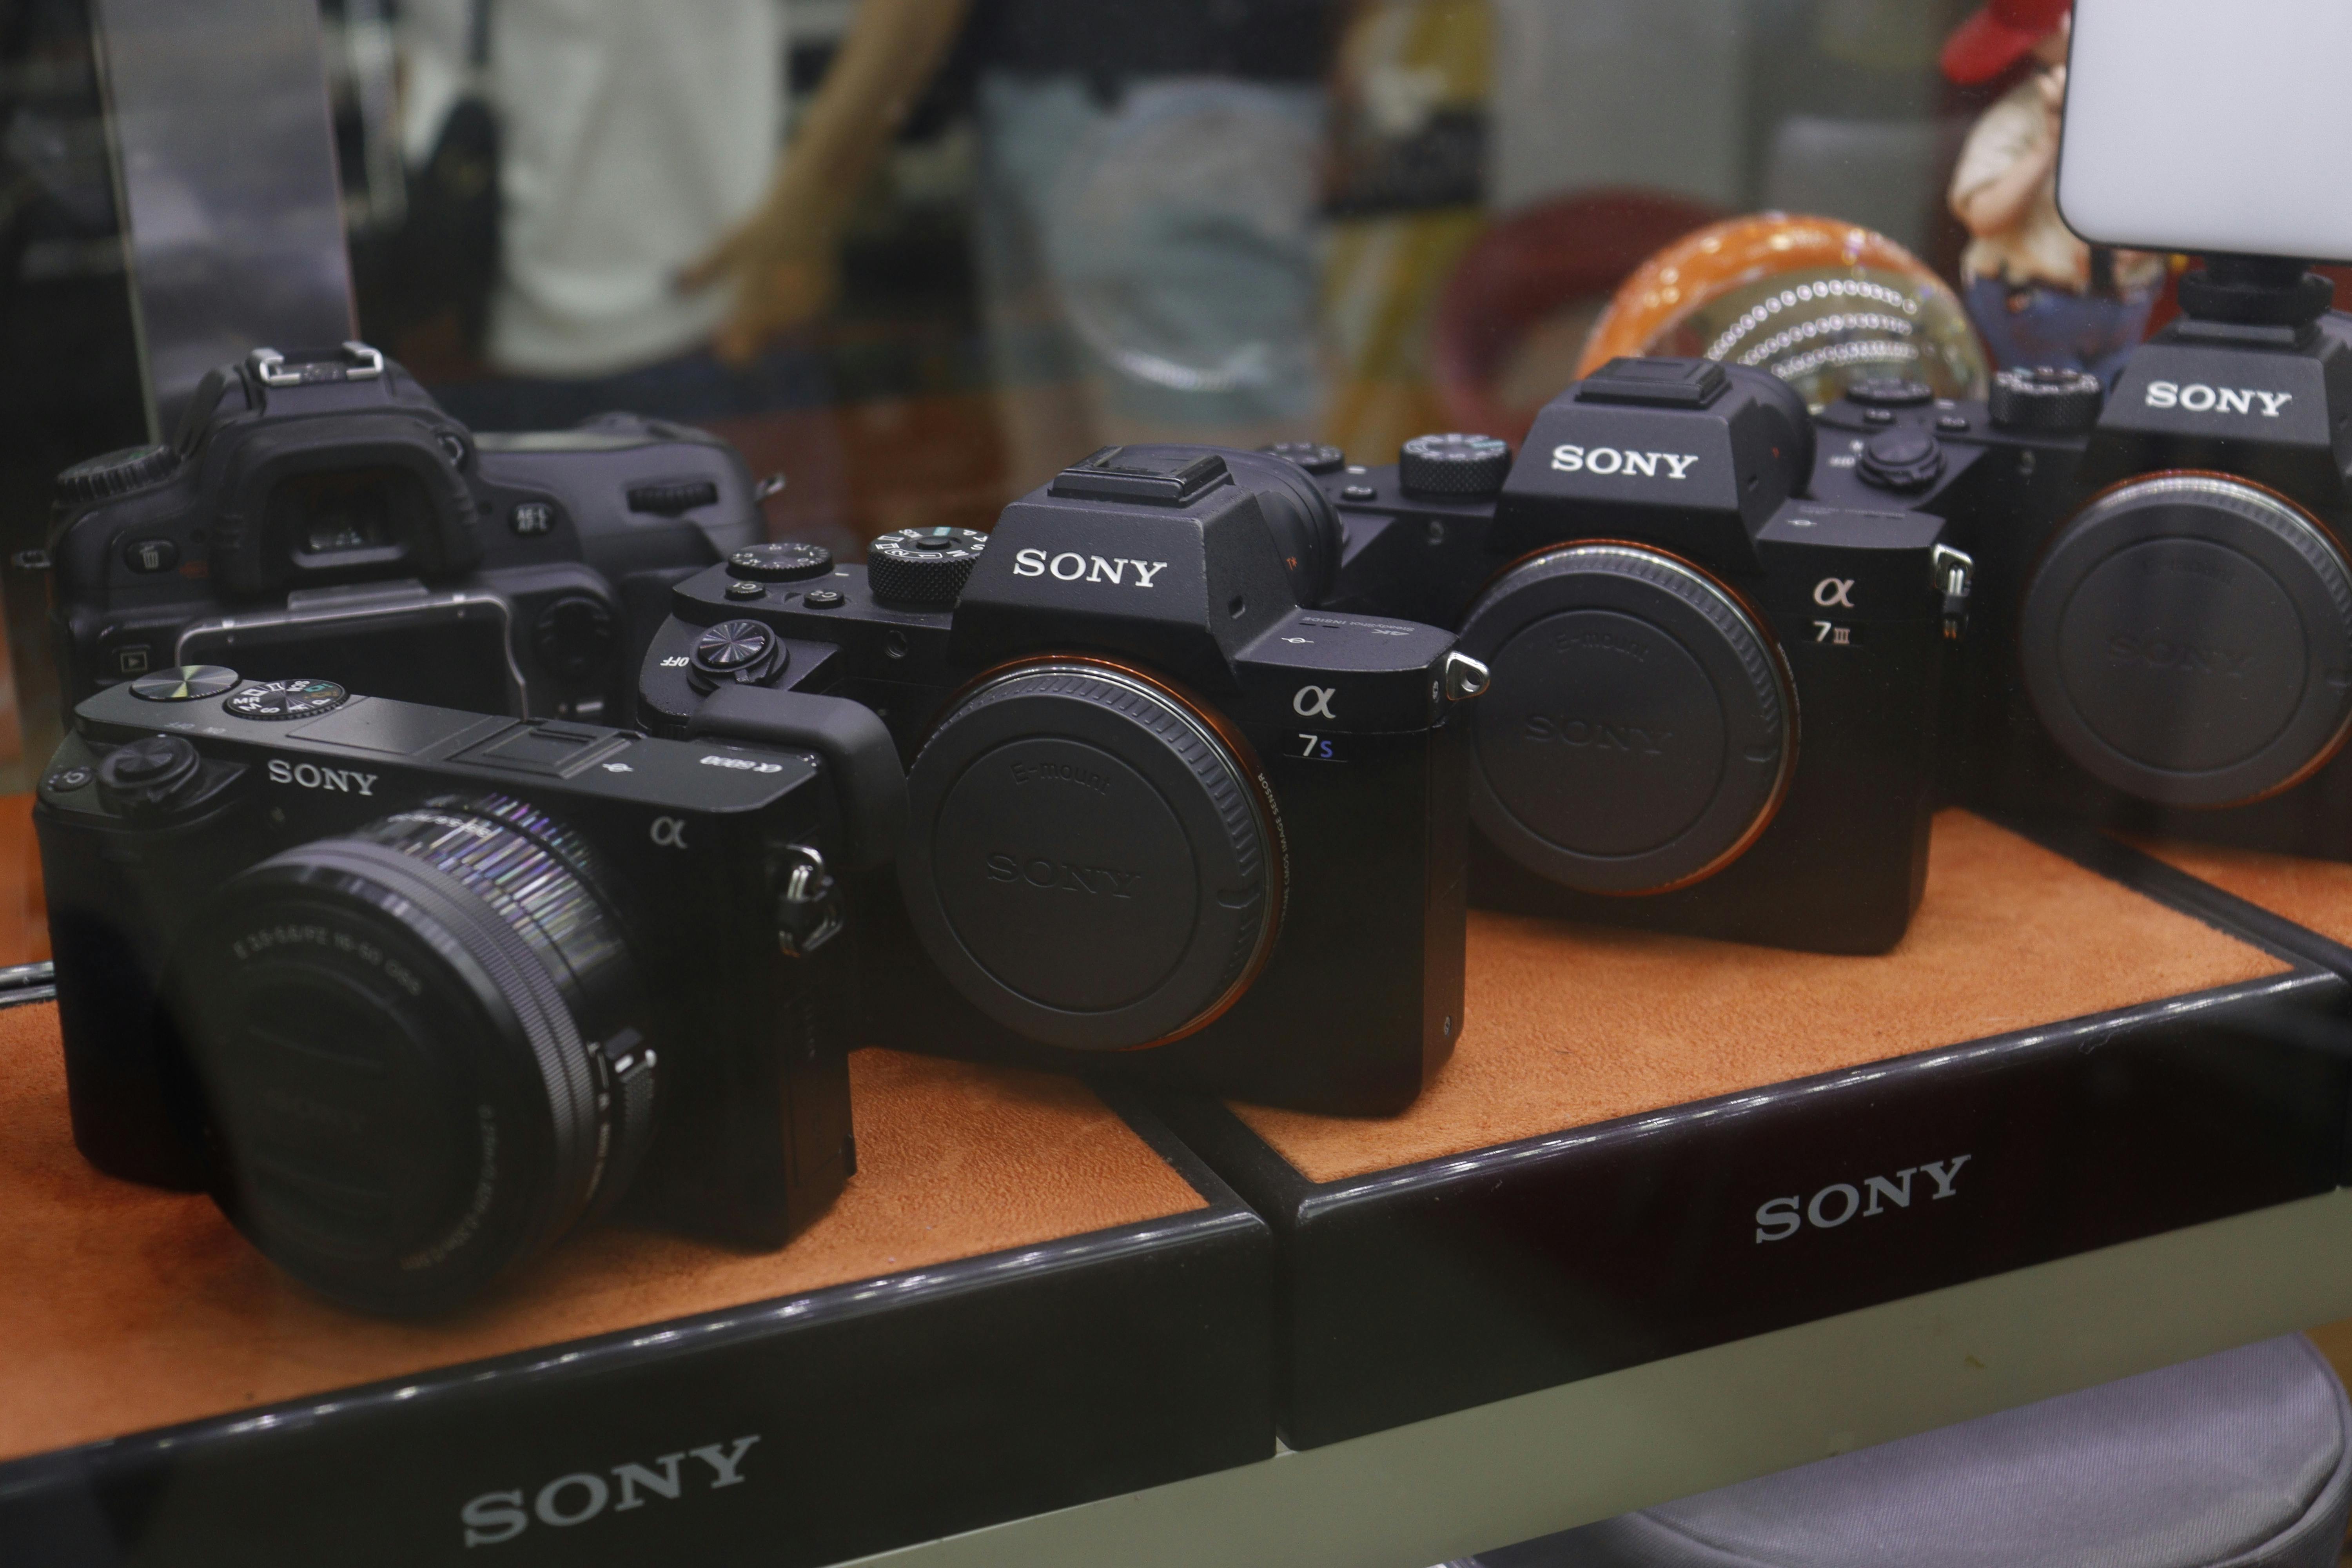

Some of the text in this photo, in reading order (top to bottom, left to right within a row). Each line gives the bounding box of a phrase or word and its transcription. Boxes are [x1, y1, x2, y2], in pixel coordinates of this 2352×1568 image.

[2145, 380, 2293, 417] SONY
[1551, 444, 1699, 479] SONY
[1013, 548, 1168, 588] SONY
[1813, 577, 1855, 608] α
[1302, 617, 1347, 625] INSIDE
[660, 656, 690, 667] OFF
[1293, 685, 1336, 719] α
[1525, 714, 1675, 755] SONY
[267, 758, 379, 796] SONY
[1010, 762, 1111, 796] E-mount
[1258, 772, 1279, 815] SENSOR
[650, 816, 688, 849] α
[1275, 816, 1288, 853] IMAGE
[987, 852, 1142, 899] SONY
[1755, 1154, 1972, 1244] SONY
[461, 1435, 760, 1548] SONY
